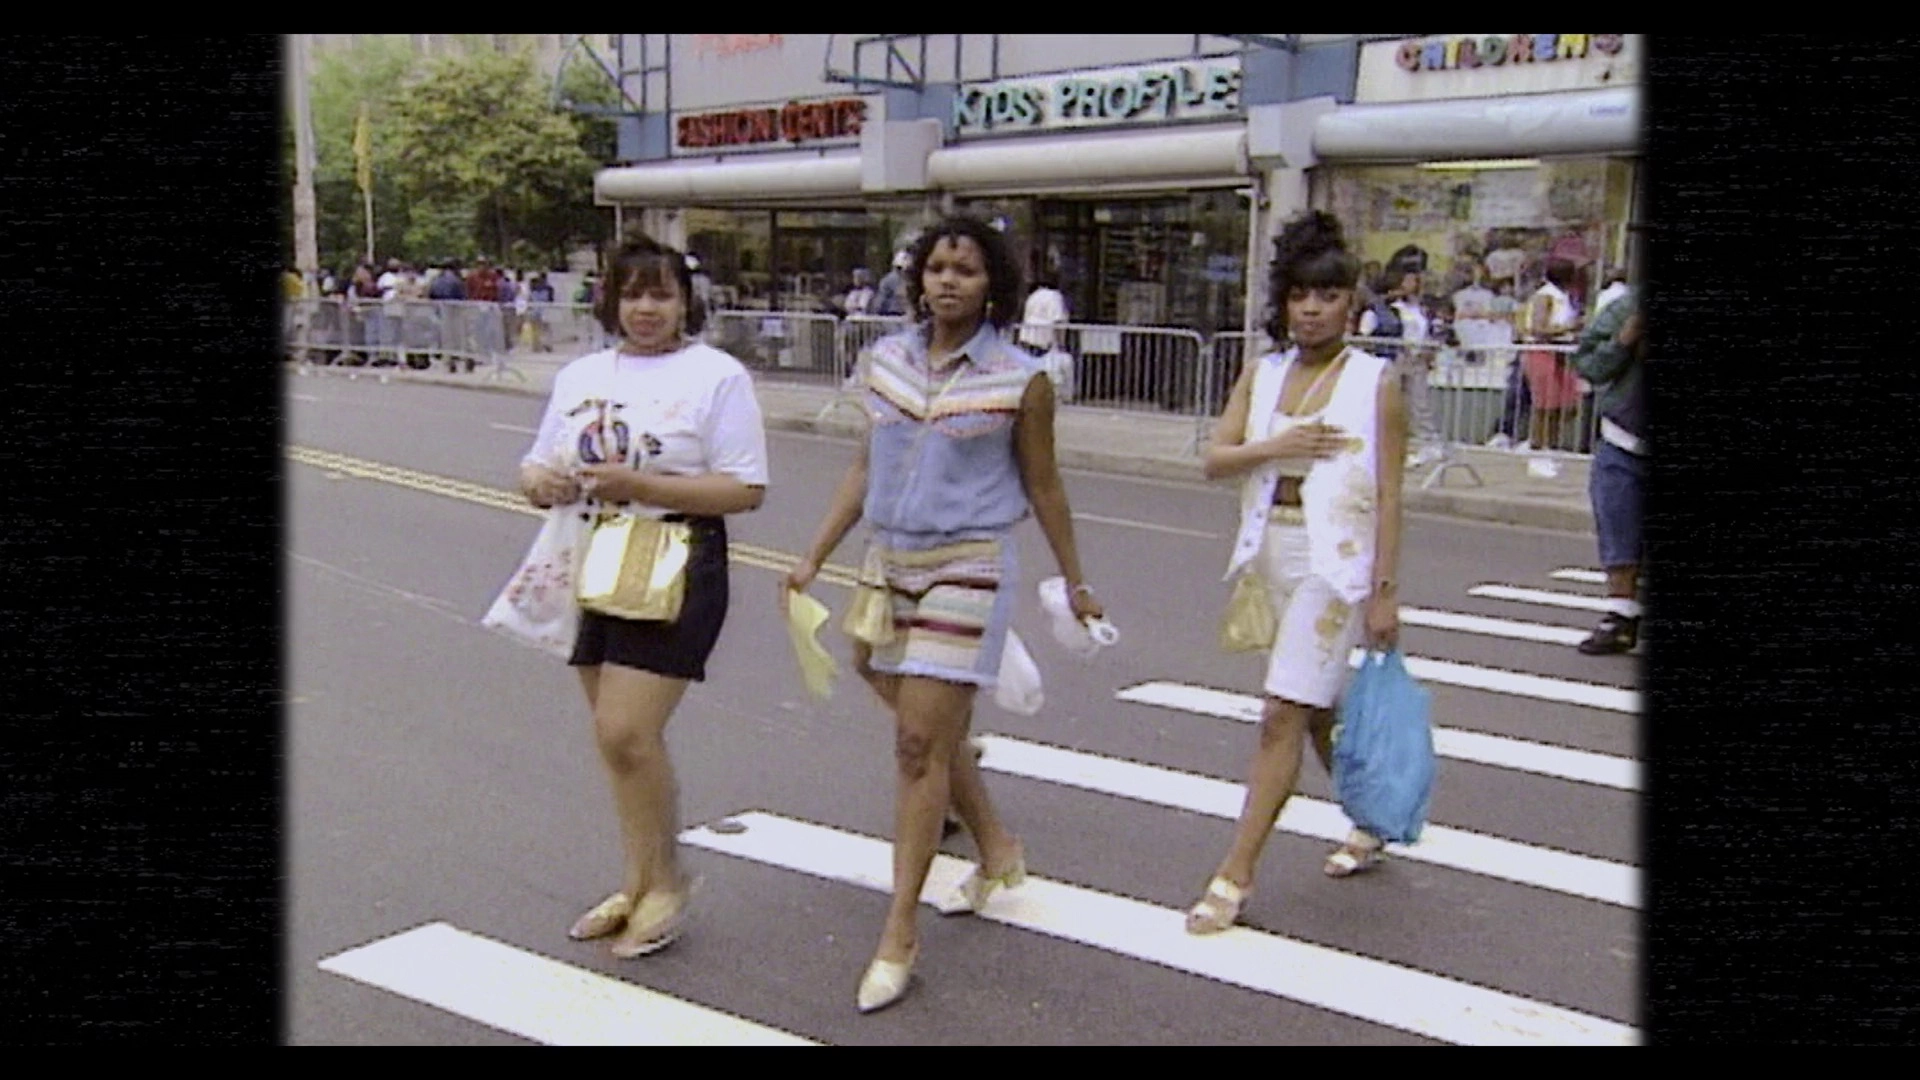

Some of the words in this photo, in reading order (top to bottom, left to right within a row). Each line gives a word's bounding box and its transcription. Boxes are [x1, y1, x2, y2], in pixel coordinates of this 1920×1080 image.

[953, 82, 1043, 130] KIDS
[1052, 66, 1241, 118] PROFILE
[678, 107, 778, 147] FASHION
